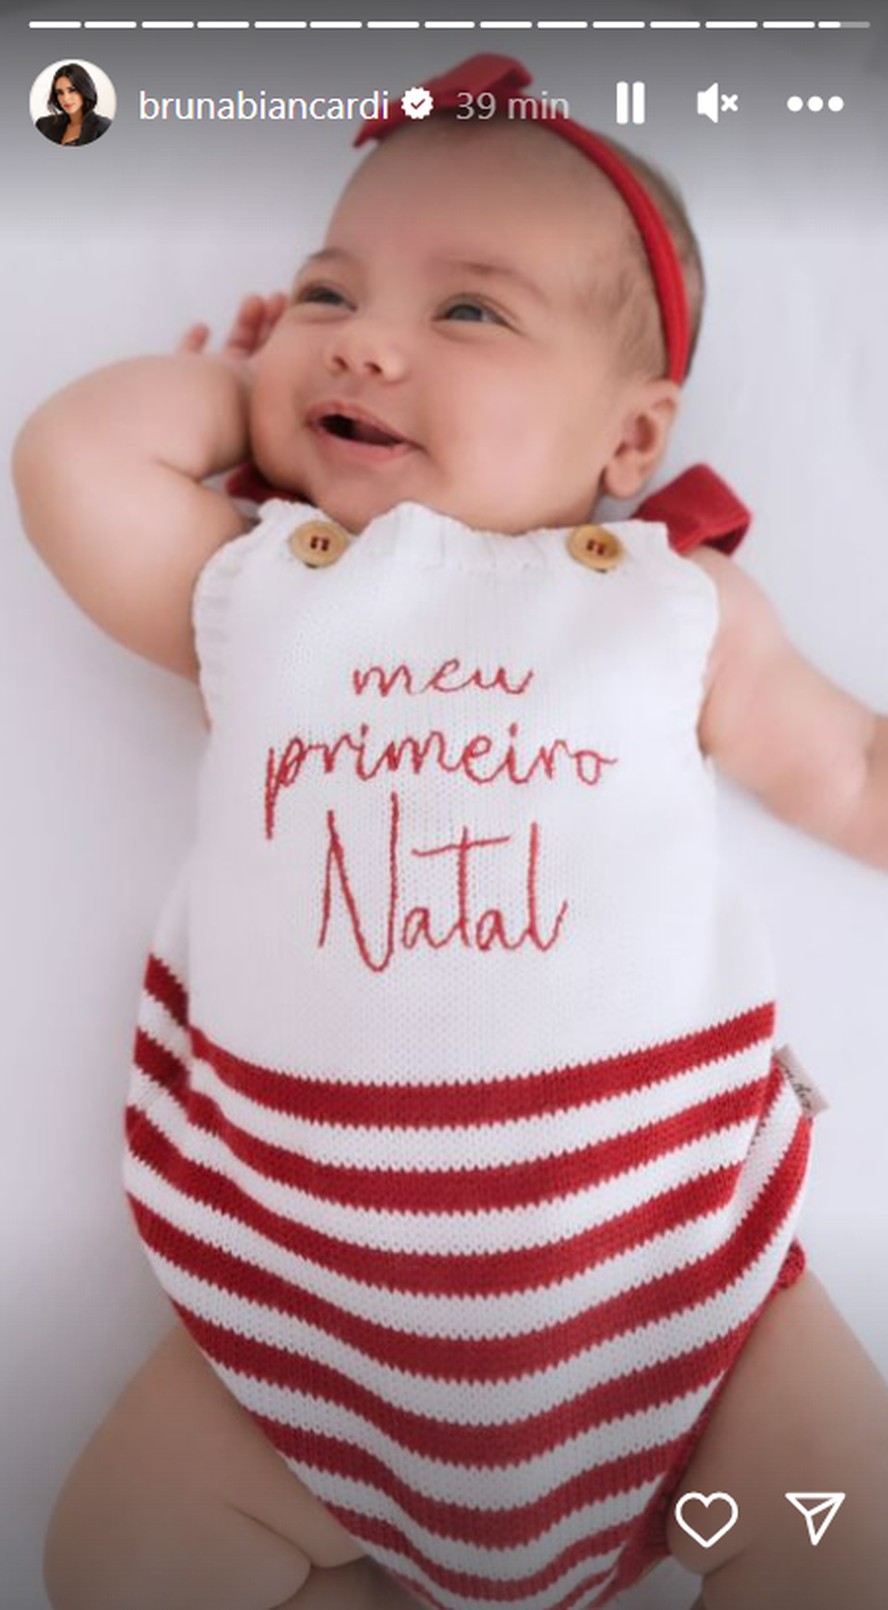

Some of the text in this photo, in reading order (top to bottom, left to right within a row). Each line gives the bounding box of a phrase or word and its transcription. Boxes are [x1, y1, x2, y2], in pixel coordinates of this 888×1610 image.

[353, 658, 534, 698] meu
[264, 722, 618, 840] primeiro
[317, 791, 568, 973] Natal
